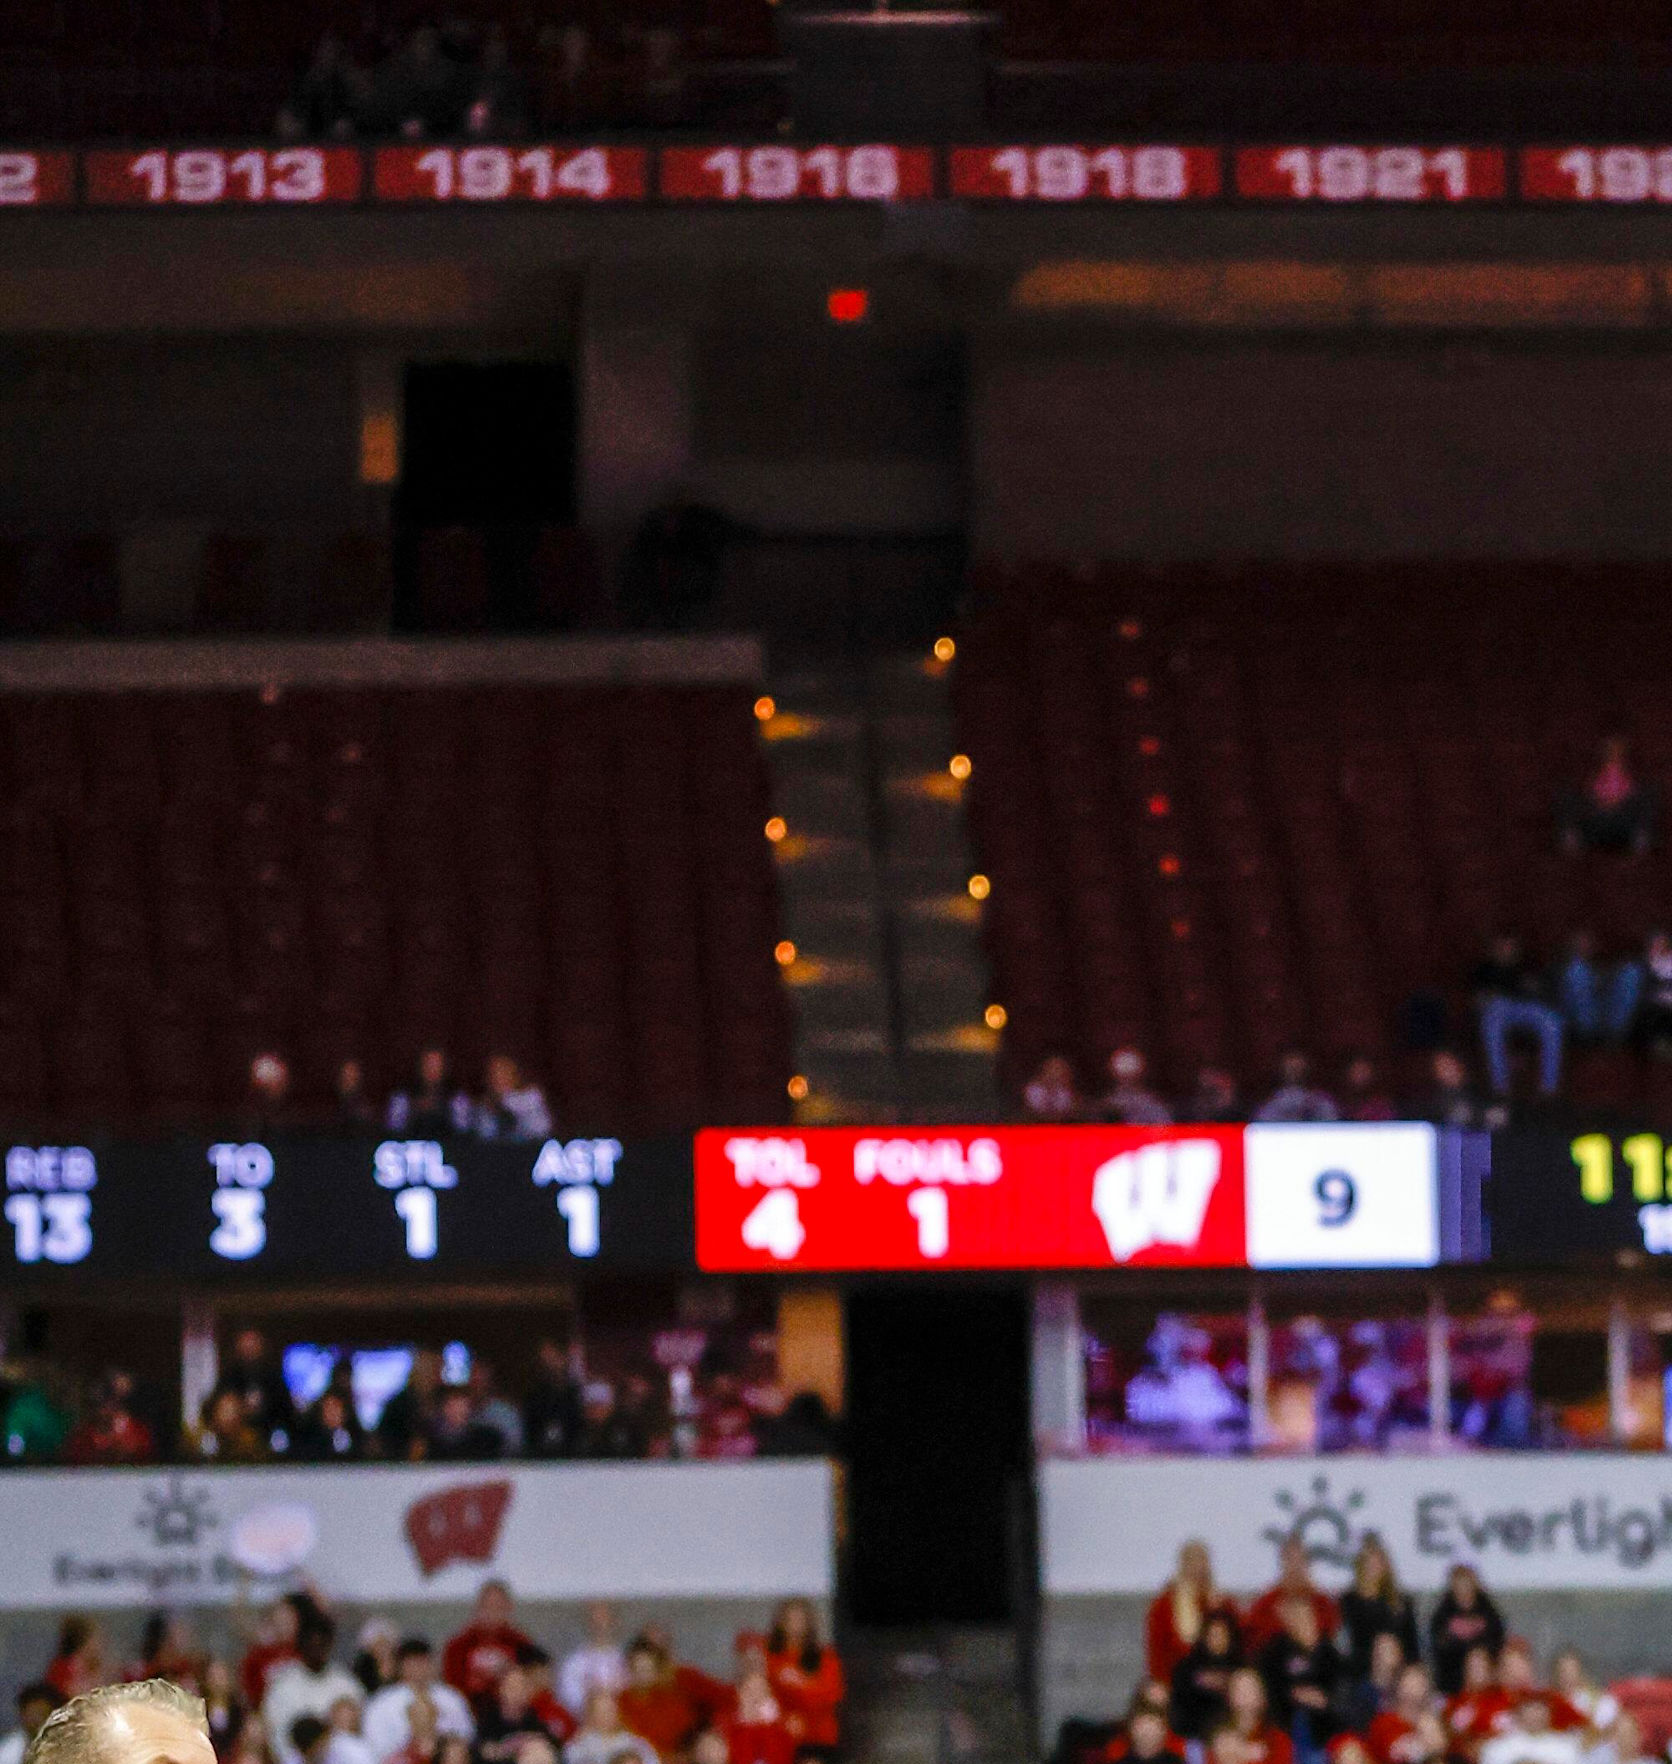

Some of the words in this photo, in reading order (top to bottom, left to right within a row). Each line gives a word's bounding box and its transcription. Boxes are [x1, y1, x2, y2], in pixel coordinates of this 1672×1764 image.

[131, 149, 326, 202] 1913
[415, 147, 611, 201] 1914
[990, 146, 1187, 200] 1918
[1275, 147, 1468, 200] 1921
[207, 1142, 275, 1188] TO
[373, 1140, 458, 1189] STL
[532, 1138, 623, 1187] AST
[724, 1137, 821, 1187] TOL
[852, 1138, 1002, 1185] FOULS
[210, 1188, 267, 1260] 3
[394, 1187, 438, 1260] 1
[556, 1186, 600, 1258] 1
[741, 1187, 806, 1260] 4
[907, 1186, 950, 1258] 1
[1311, 1168, 1357, 1229] 9
[5, 1191, 93, 1263] 13
